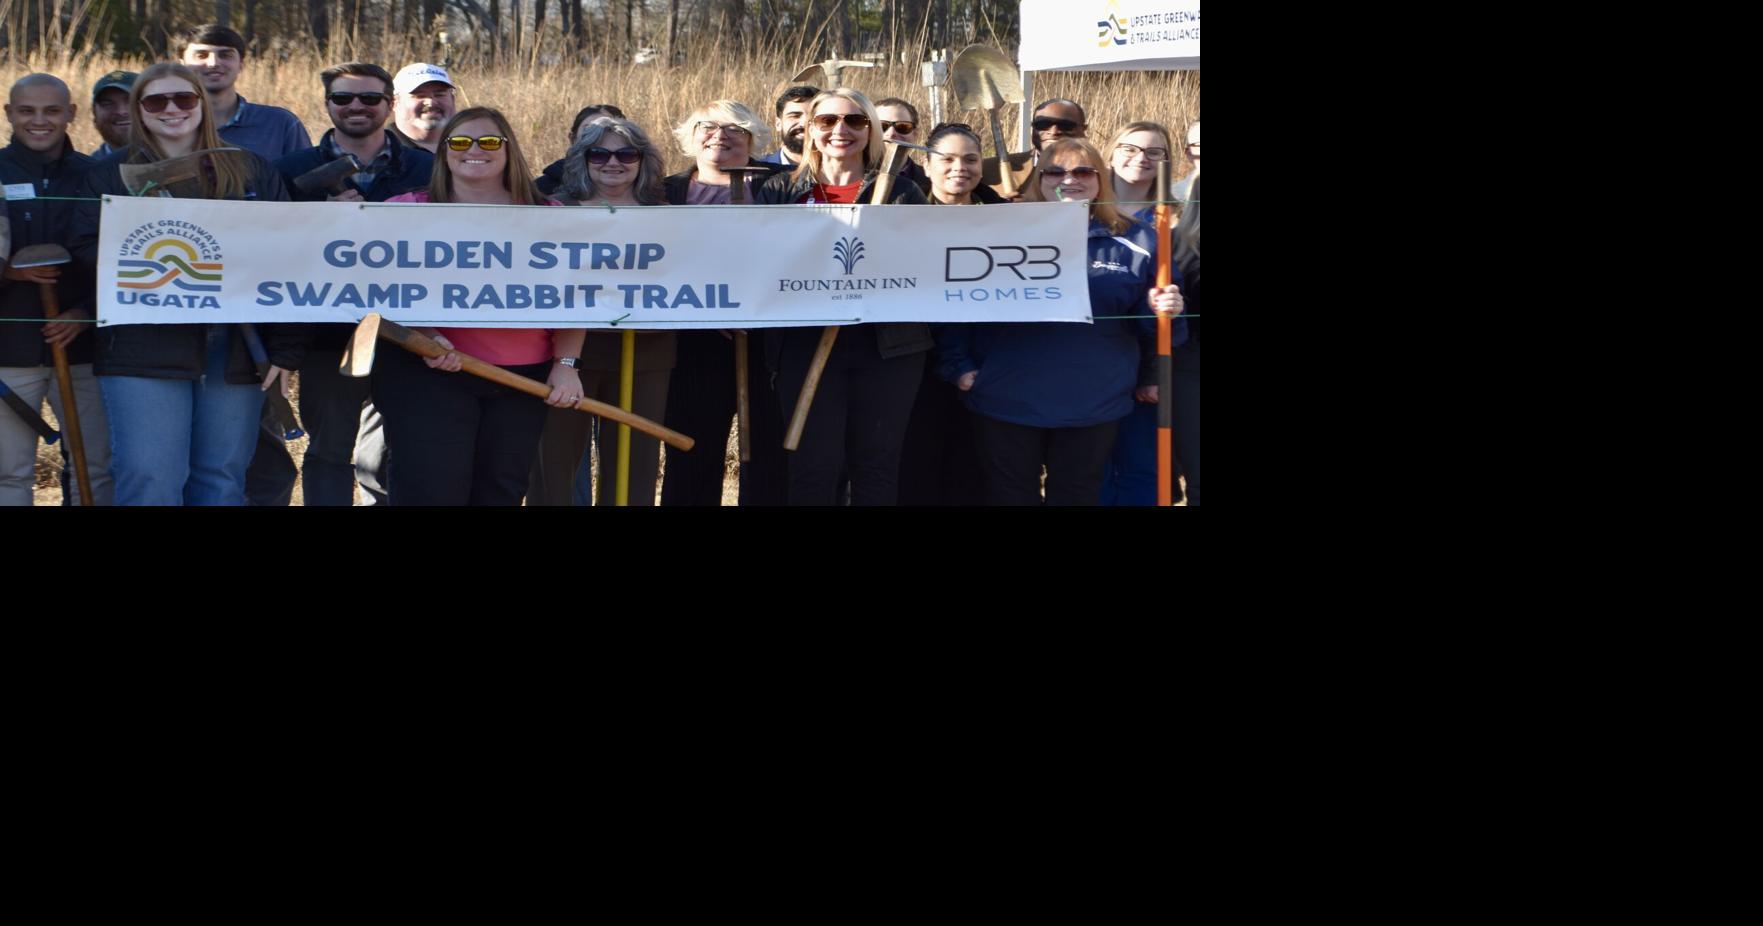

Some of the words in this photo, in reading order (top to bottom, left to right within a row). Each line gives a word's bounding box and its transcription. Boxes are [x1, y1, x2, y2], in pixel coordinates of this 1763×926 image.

[1130, 14, 1161, 27] UPSTATE
[1136, 31, 1161, 42] TRAILS
[1163, 28, 1199, 41] ALLIANCE
[120, 222, 154, 256] UPSTATE
[158, 220, 221, 252] GREENWAYS
[131, 228, 164, 256] TRAILS
[166, 228, 212, 261] ALLIANCE
[323, 240, 512, 268] GOLDEN
[528, 242, 665, 270] STRIP
[945, 246, 1061, 282] DRB
[256, 281, 428, 308] SWAMP
[442, 284, 603, 309] RABBIT
[618, 284, 741, 308] TRAIL
[778, 278, 878, 292] FOUNTAIN
[882, 278, 917, 288] INN
[945, 287, 1062, 302] HOMES
[116, 291, 221, 308] UGATA
